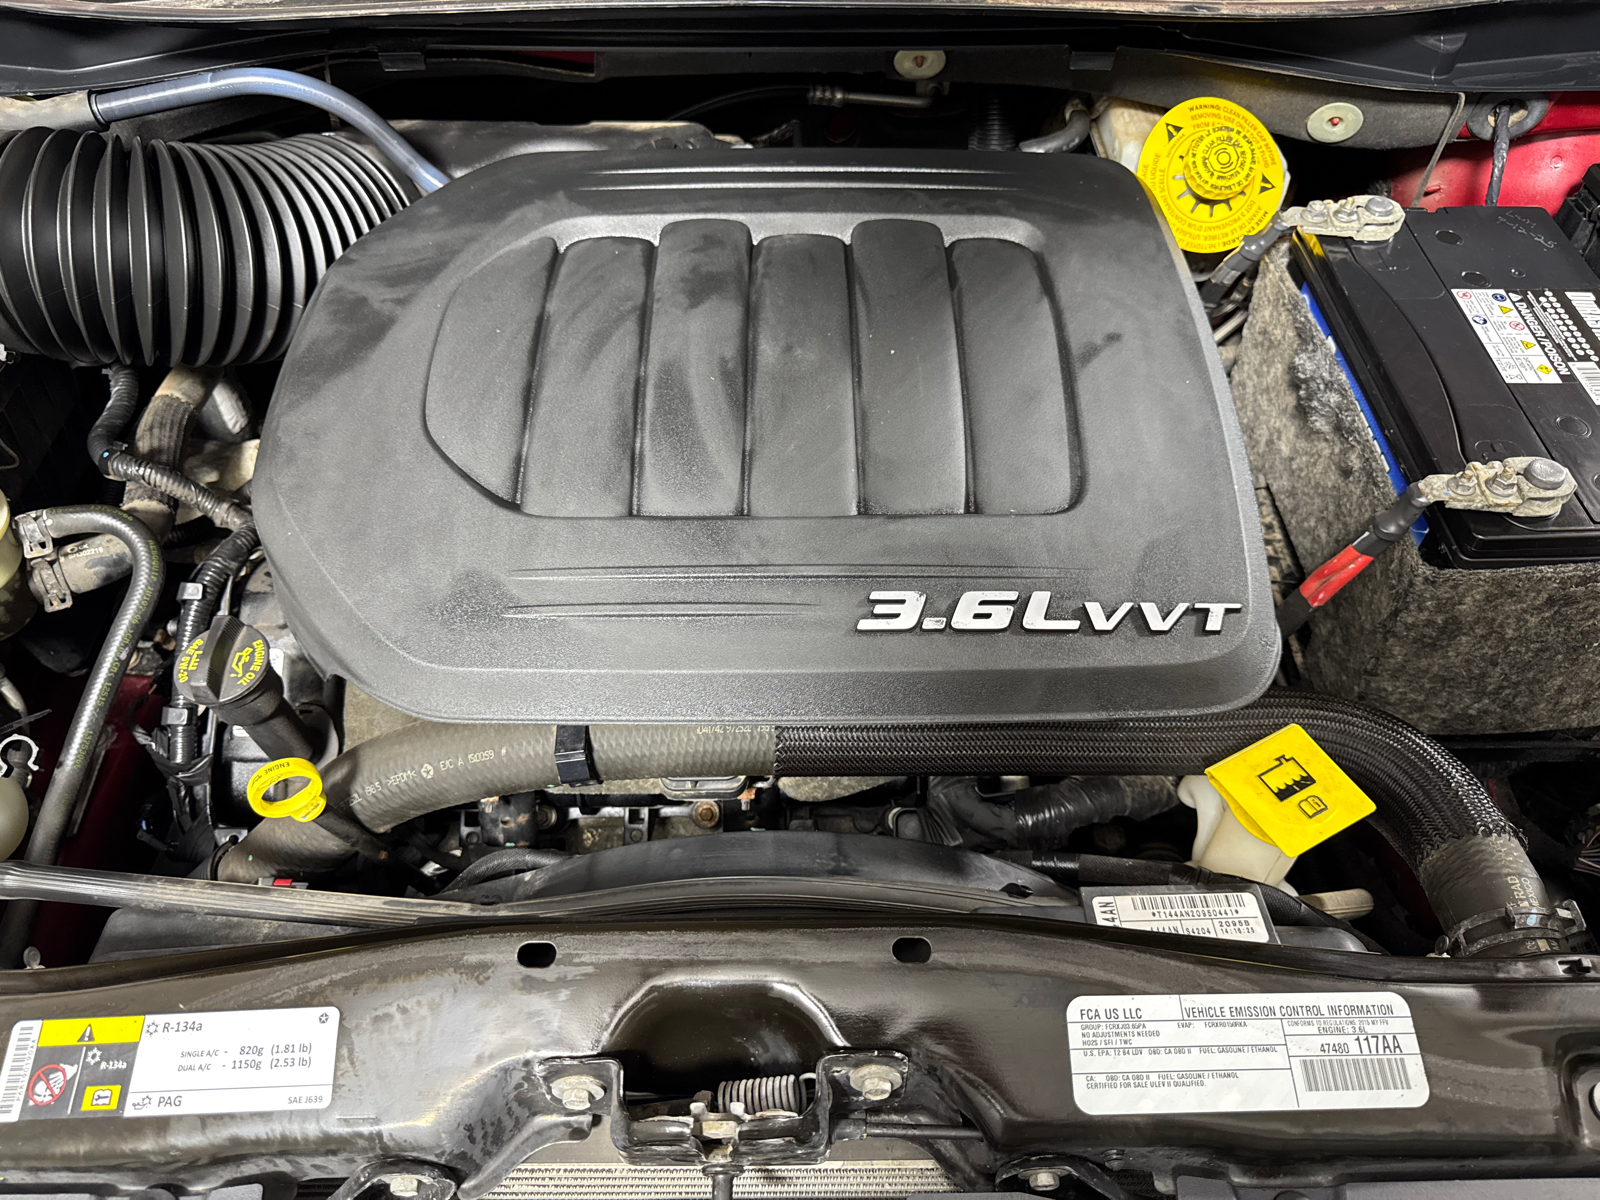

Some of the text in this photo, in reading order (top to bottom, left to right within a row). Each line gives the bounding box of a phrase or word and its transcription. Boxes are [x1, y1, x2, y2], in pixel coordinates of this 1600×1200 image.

[1515, 302, 1545, 337] DANGER
[856, 590, 1243, 632] 3.6L VVT
[178, 638, 204, 684] SAE 5W-20
[237, 639, 265, 686] ENGINE OIL
[264, 761, 291, 775] ENGINE
[457, 756, 465, 767] A
[1507, 876, 1525, 899] RAD
[1080, 1007, 1143, 1020] FCA US LLC
[1184, 1004, 1394, 1018] VEHICLE EMISSION CONTROL INFORMATION
[162, 1021, 203, 1033] R-134a
[1177, 1021, 1195, 1029] EVAP:
[1287, 1019, 1315, 1027] CONFORMS
[1081, 1031, 1091, 1039] NO
[1092, 1030, 1136, 1038] ADJUSTMENTS
[1317, 1026, 1368, 1034] ENGINE: 3.6L
[180, 1049, 205, 1058] SINGLE
[206, 1048, 219, 1058] A/C
[239, 1045, 264, 1058] 820g
[270, 1043, 295, 1056] (1.81
[298, 1042, 312, 1055] lb)
[1320, 1034, 1403, 1054] 47480 117AA
[1083, 1049, 1097, 1057] U.S.
[1097, 1049, 1112, 1057] EPA:
[100, 1060, 127, 1070] R-134a
[177, 1063, 197, 1072] DUAL
[199, 1062, 211, 1072] A/C
[230, 1059, 262, 1071] 1150g
[269, 1057, 295, 1070] (2.53
[297, 1056, 312, 1069] lb)
[1176, 1072, 1206, 1080] GASOLINE
[1119, 1081, 1132, 1089] FOR
[1149, 1080, 1166, 1088] ULEV
[157, 1095, 183, 1108] PAG
[287, 1094, 323, 1105] SAE J639
